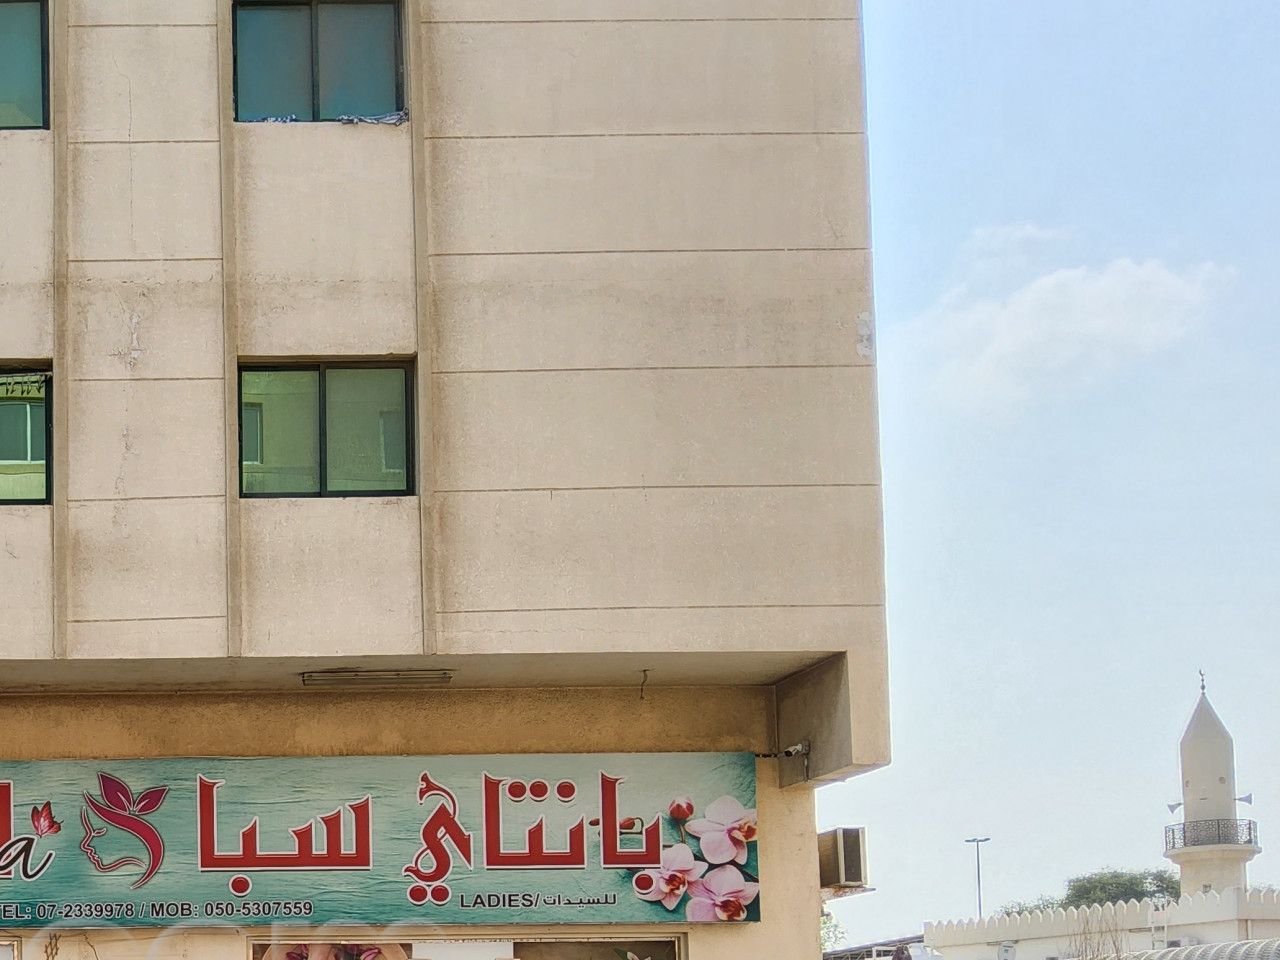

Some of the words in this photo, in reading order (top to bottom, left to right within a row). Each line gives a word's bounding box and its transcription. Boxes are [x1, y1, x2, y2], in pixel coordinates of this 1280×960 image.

[197, 772, 373, 897] سبا
[36, 902, 135, 919] 07-2339978
[150, 902, 199, 918] MOB:
[204, 901, 313, 917] 050-5307559
